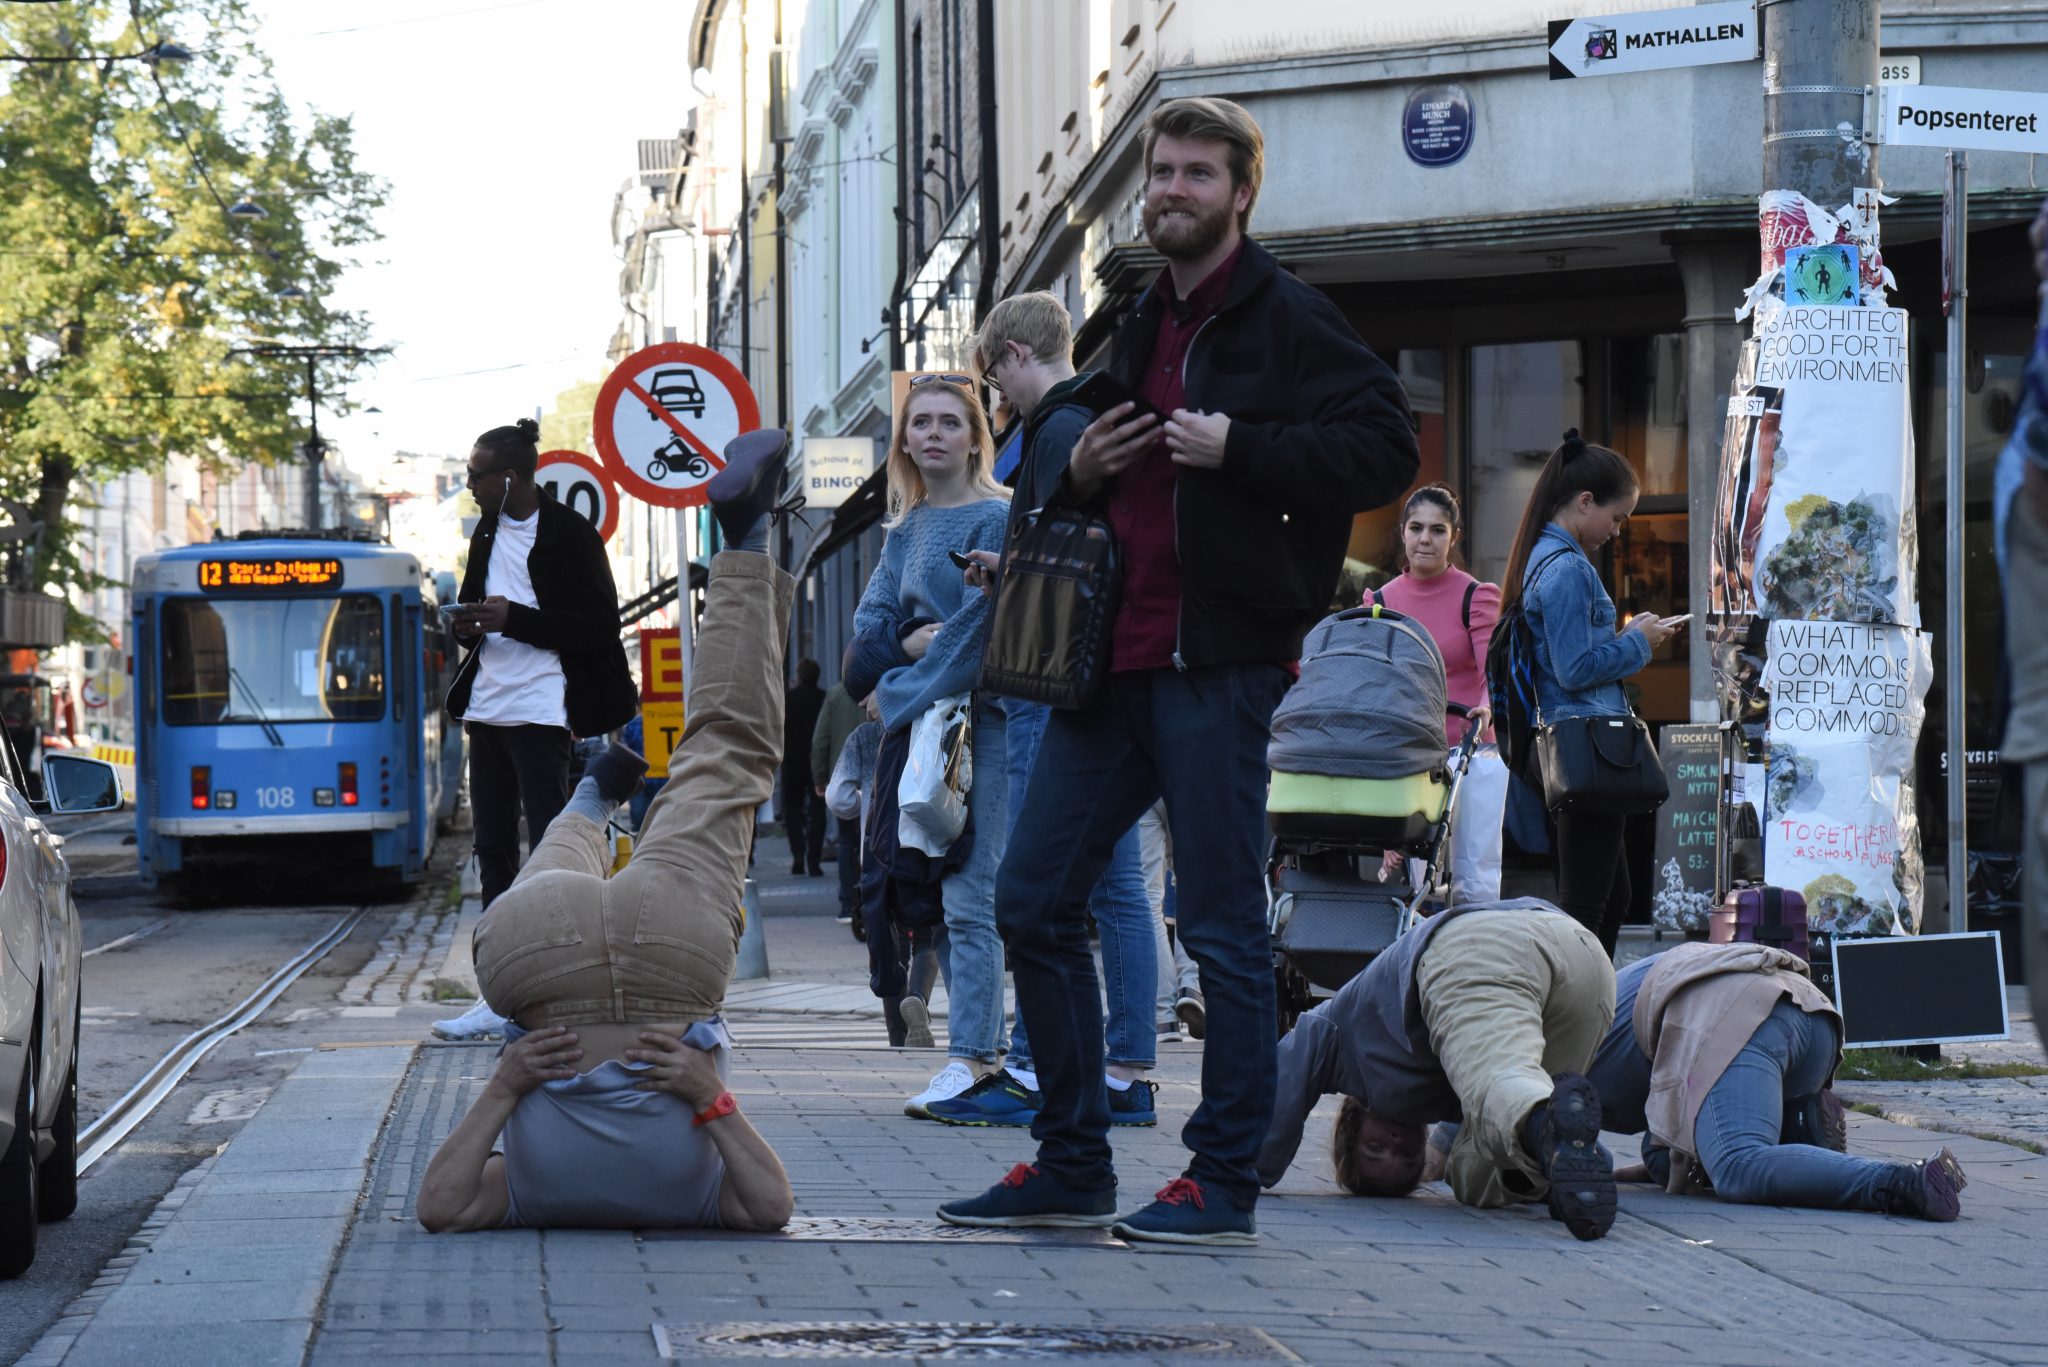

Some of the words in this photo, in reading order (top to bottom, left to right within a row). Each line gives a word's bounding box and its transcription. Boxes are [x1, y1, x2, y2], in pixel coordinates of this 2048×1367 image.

[1625, 23, 1744, 50] MATHALLEN
[1881, 66, 1910, 80] ass
[1421, 102, 1452, 111] EDVARD
[1421, 110, 1451, 120] MUNCH
[1897, 105, 2038, 133] Popsenteret
[1763, 333, 1826, 359] GOOD
[1831, 334, 1878, 357] FOR
[811, 476, 866, 489] BINGO
[201, 562, 222, 586] 12
[1778, 624, 1862, 650] WHAT
[1866, 626, 1884, 651] IF
[1777, 652, 1910, 682] COMMONS
[1776, 680, 1908, 709] REPLACED
[1671, 732, 1720, 744] STOCKFLE
[256, 787, 295, 808] 108
[1678, 831, 1716, 846] LATTE
